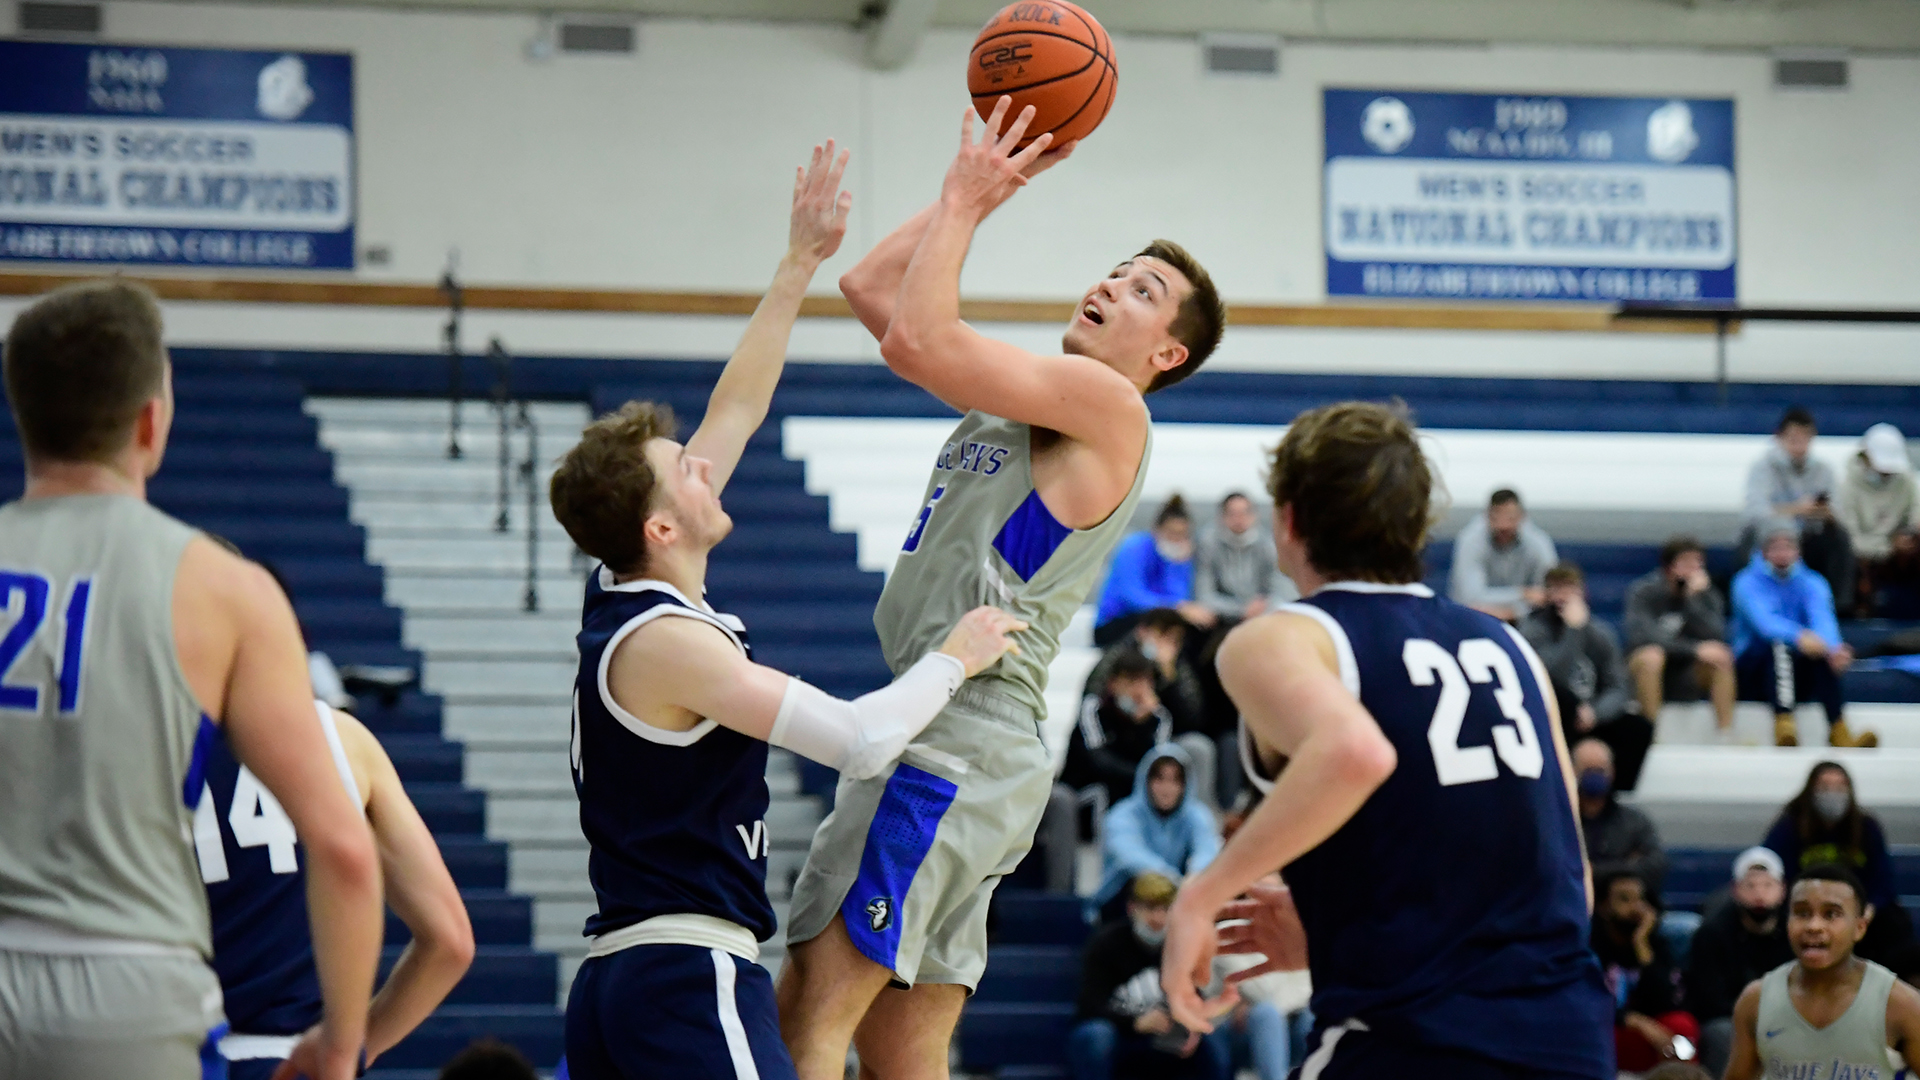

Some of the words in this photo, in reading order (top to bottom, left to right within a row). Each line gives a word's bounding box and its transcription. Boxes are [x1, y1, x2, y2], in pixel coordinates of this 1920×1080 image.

[1009, 4, 1064, 26] ROCK
[115, 132, 255, 163] SOCCER
[119, 171, 340, 214] CHAMPIONS
[1521, 176, 1646, 203] SOCCER
[1338, 207, 1514, 246] NATIONAL
[1525, 211, 1723, 251] CHAMPIONS
[1362, 264, 1578, 298] ELIZABETHTOWN
[0, 568, 95, 715] 21
[1402, 637, 1544, 786] 23
[193, 763, 298, 884] 14
